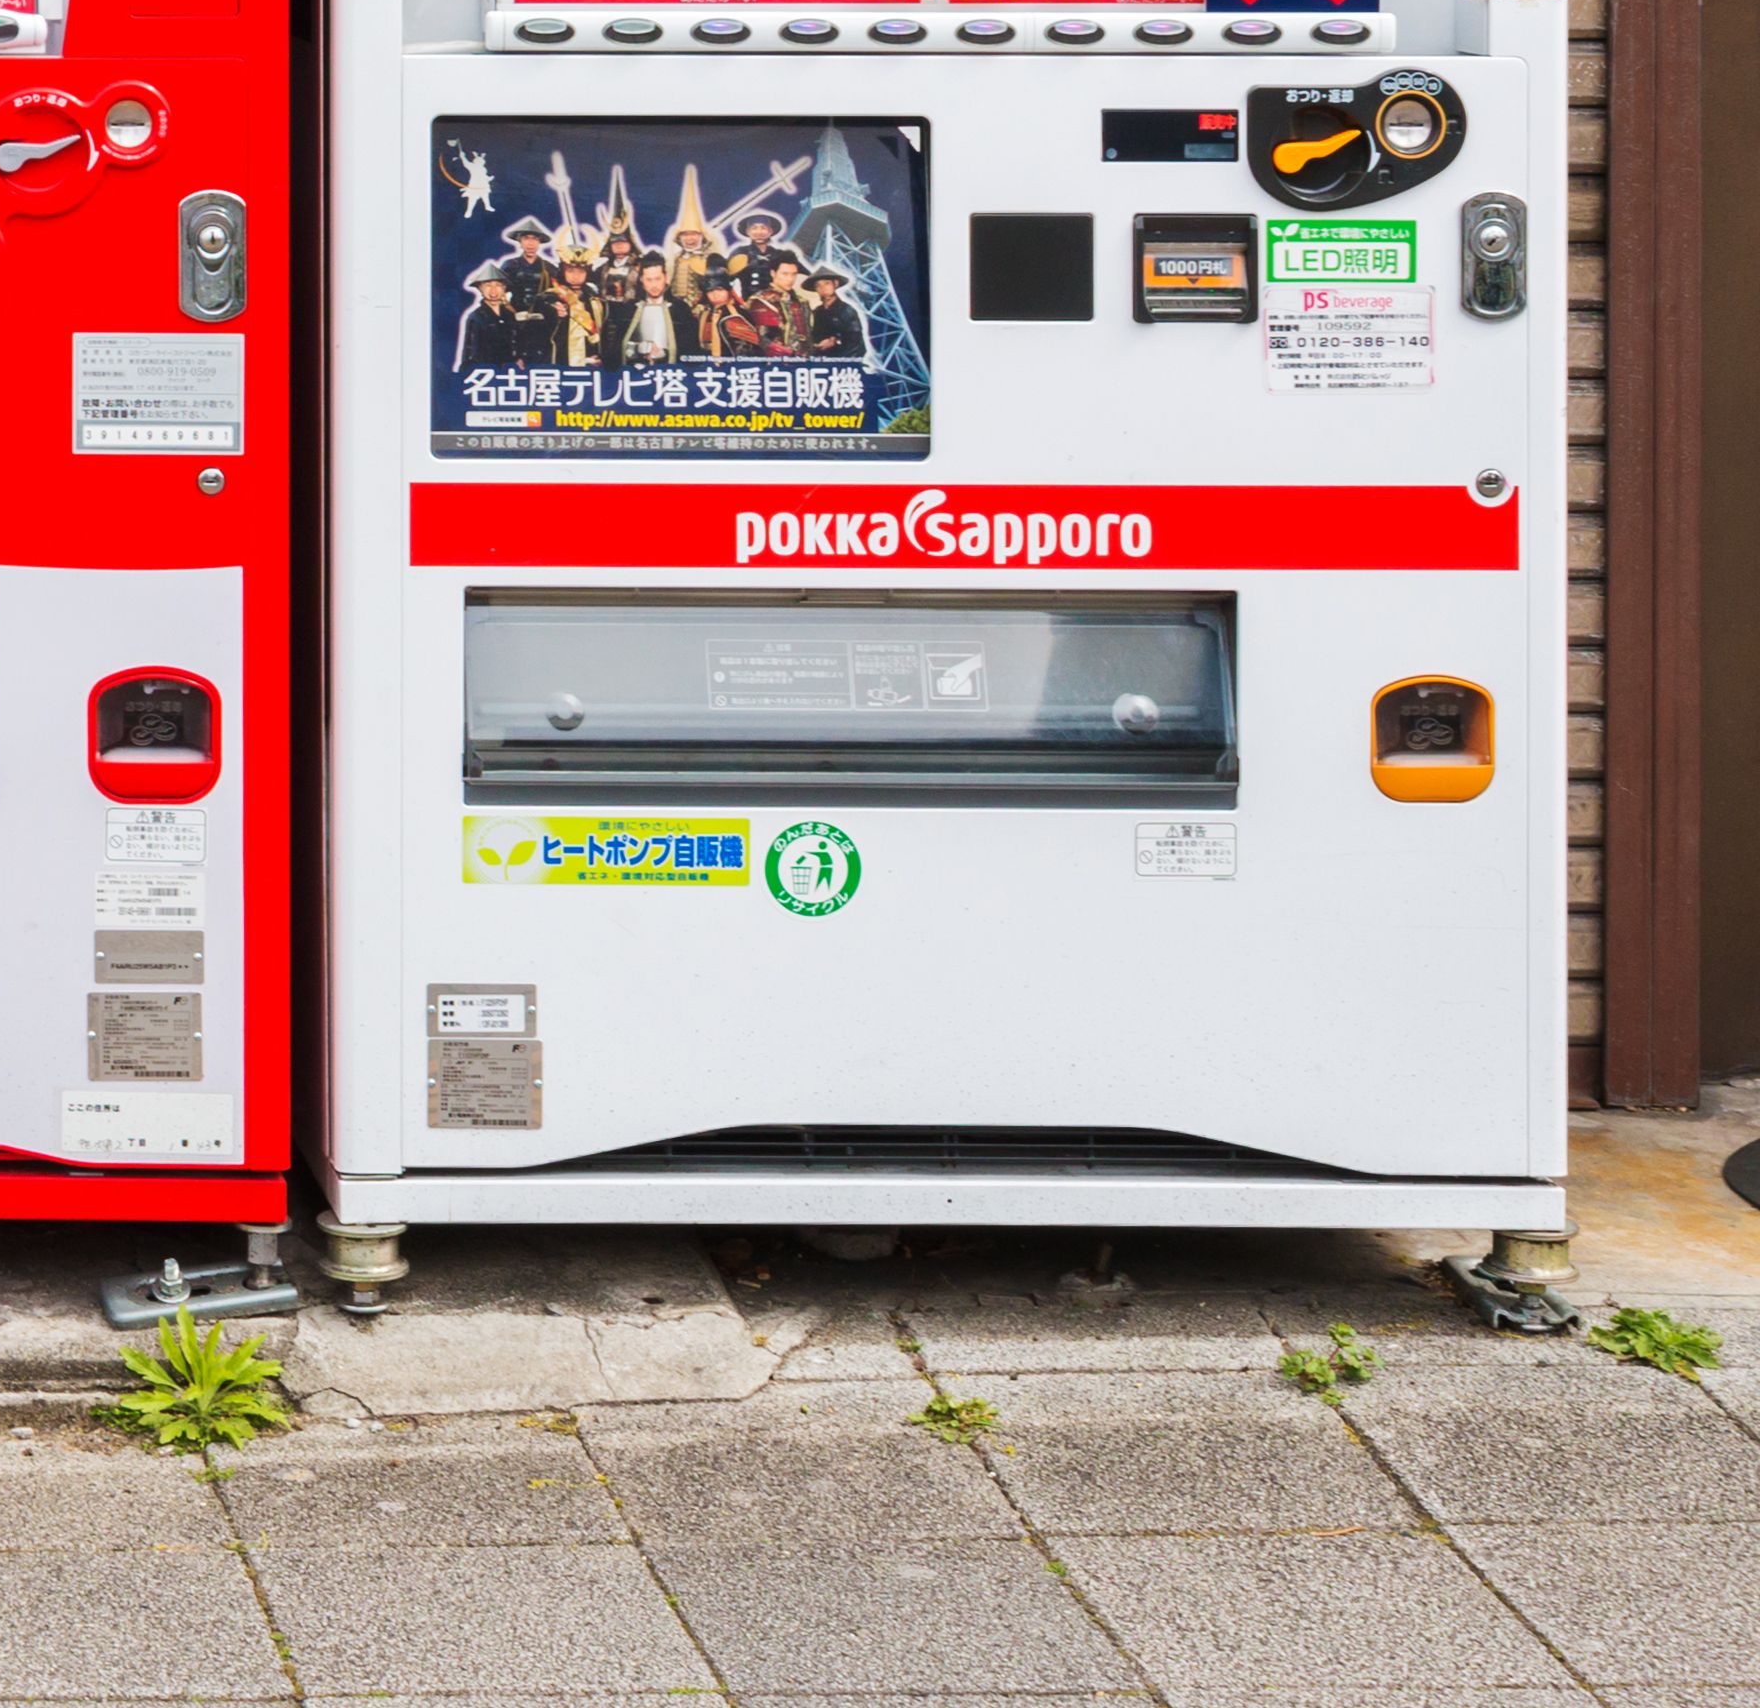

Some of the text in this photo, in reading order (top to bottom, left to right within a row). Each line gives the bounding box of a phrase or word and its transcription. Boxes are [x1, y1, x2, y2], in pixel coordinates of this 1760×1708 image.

[1159, 259, 1228, 276] 1000円札
[1283, 248, 1399, 275] LED照明
[1333, 293, 1394, 312] beverage
[735, 508, 899, 563] pokka
[542, 834, 743, 870] ヒートポンプ自販機
